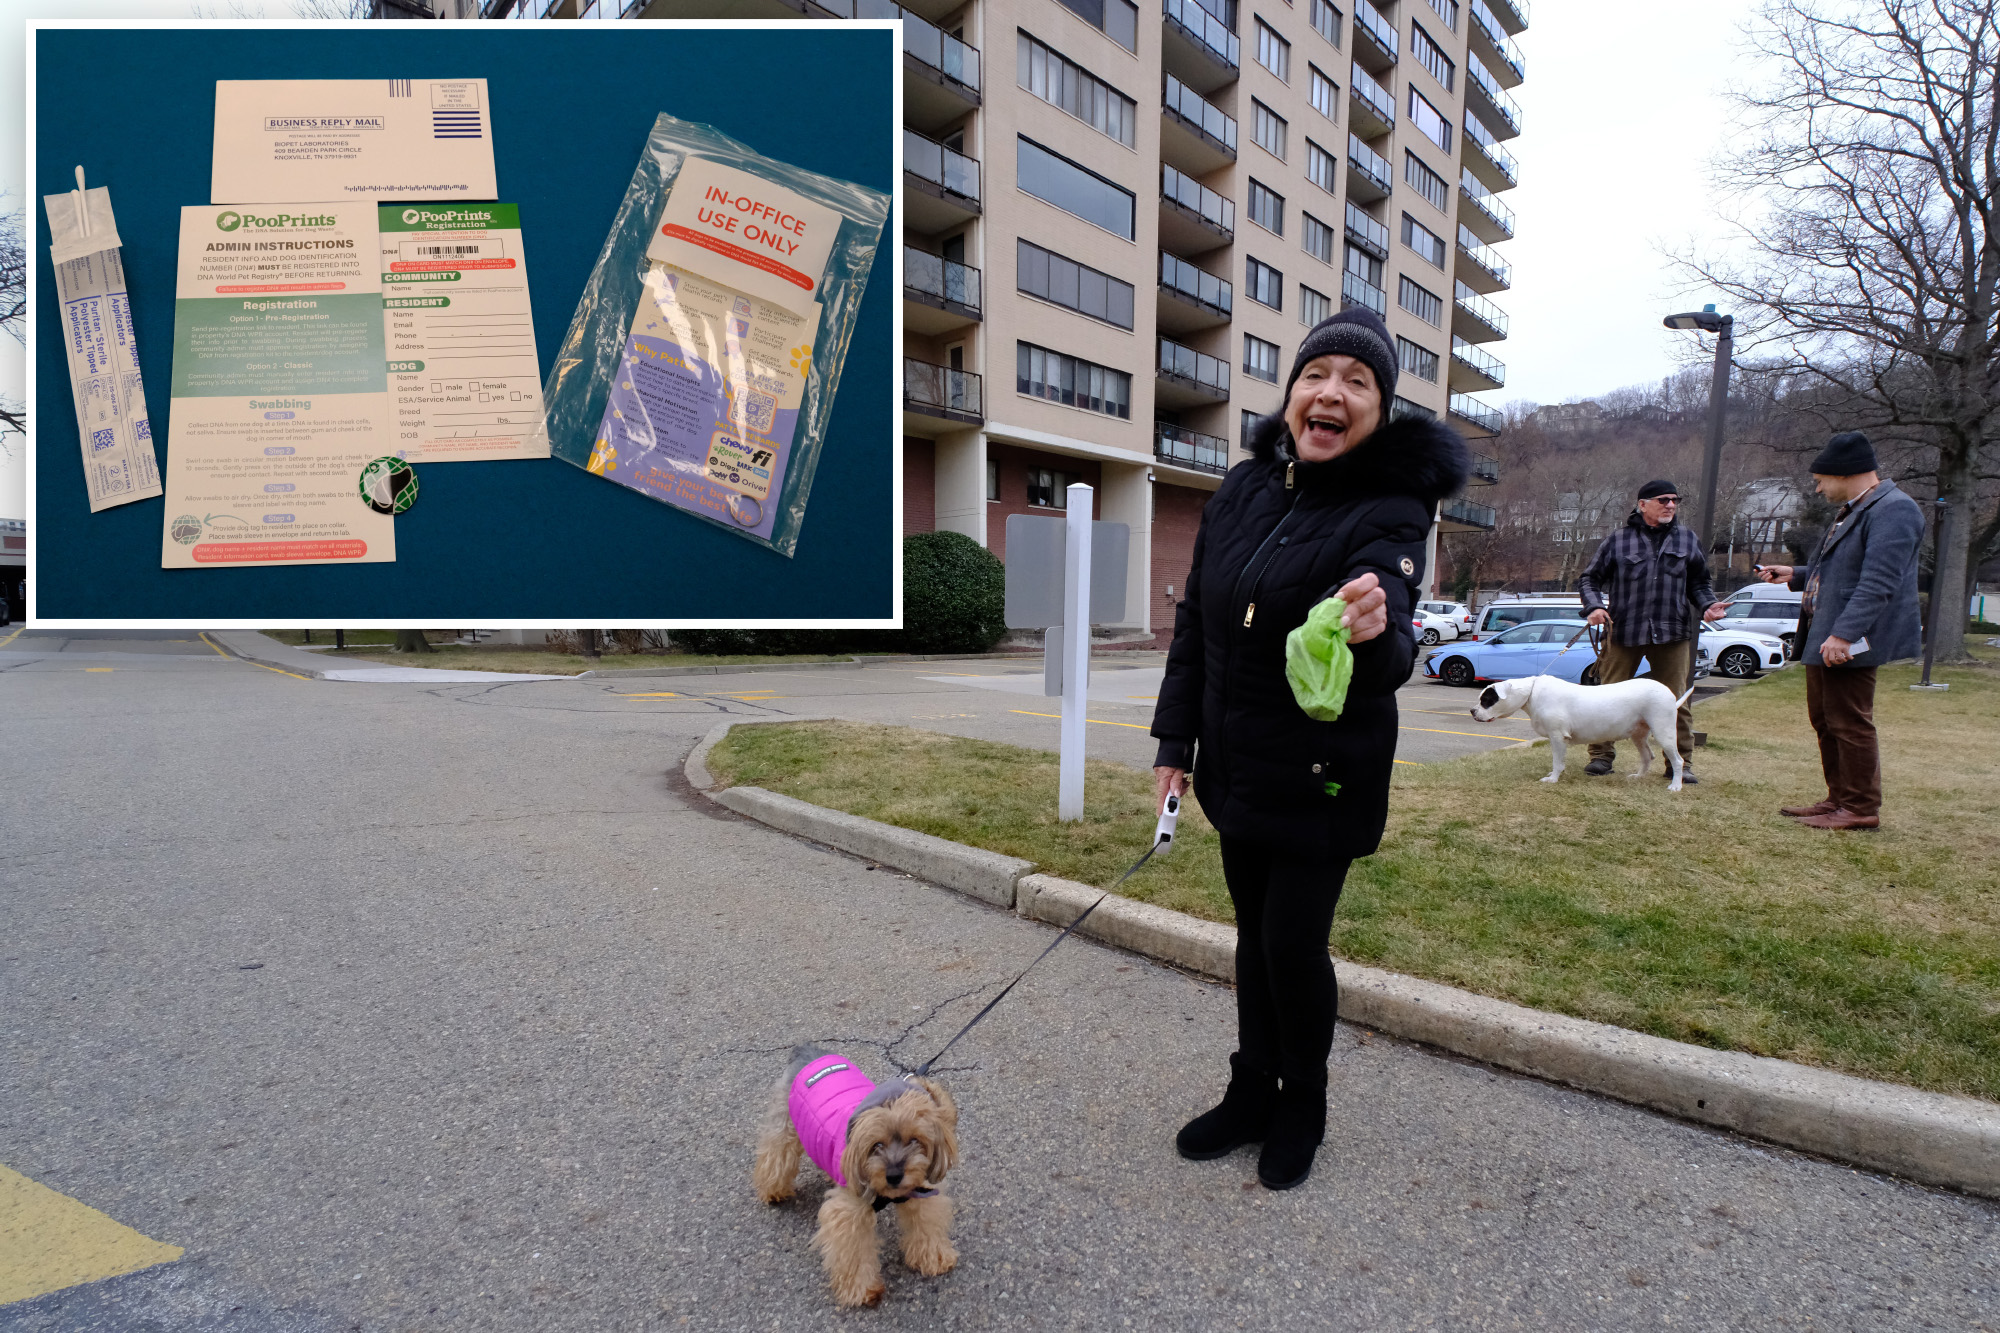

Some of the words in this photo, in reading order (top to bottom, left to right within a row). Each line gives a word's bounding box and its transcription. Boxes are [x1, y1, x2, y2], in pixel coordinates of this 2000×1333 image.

[420, 210, 491, 221] PooPrints
[705, 186, 806, 237] IN-OFFICE
[242, 214, 336, 228] PooPrints
[426, 222, 486, 230] Registration
[698, 207, 739, 233] USE
[744, 225, 799, 256] ONLY
[206, 243, 251, 251] ADMIN
[255, 240, 354, 251] INSTRUCTIONS
[384, 273, 456, 282] COMMUNITY
[684, 282, 699, 291] Store
[683, 287, 700, 296] health
[702, 294, 722, 304] records
[244, 300, 317, 311] Registration
[386, 299, 443, 307] RESIDENT
[112, 298, 125, 346] Applicators
[266, 313, 329, 322] Pre-Registration
[701, 311, 719, 320] weekly
[758, 316, 779, 326] content
[774, 311, 799, 322] informed
[774, 316, 799, 327] scientific
[70, 306, 83, 353] Applicators
[90, 301, 101, 332] Puritan
[96, 337, 107, 365] Sterile
[122, 297, 135, 336] Polyester
[130, 340, 140, 367] Tipped
[755, 327, 786, 341] Participate
[80, 303, 92, 342] Polyester
[87, 345, 98, 374] Tipped
[635, 342, 657, 359] Why
[660, 352, 697, 372] Patter
[640, 360, 674, 377] Educational
[676, 374, 700, 386] Insights
[759, 375, 772, 383] THE
[765, 384, 787, 396] START
[249, 399, 311, 410] Swabbing
[665, 399, 698, 415] Motivation
[720, 437, 753, 454] chewy
[745, 432, 780, 449] REWARDS
[718, 446, 742, 460] Rover
[751, 450, 772, 467] fi
[720, 461, 739, 472] Diggs
[737, 461, 752, 472] BARK
[634, 471, 672, 492] friend
[676, 487, 696, 501] the
[700, 495, 726, 512] best
[648, 467, 675, 482] give
[679, 478, 704, 492] your
[710, 487, 732, 503] bes
[742, 479, 766, 492] Orivet
